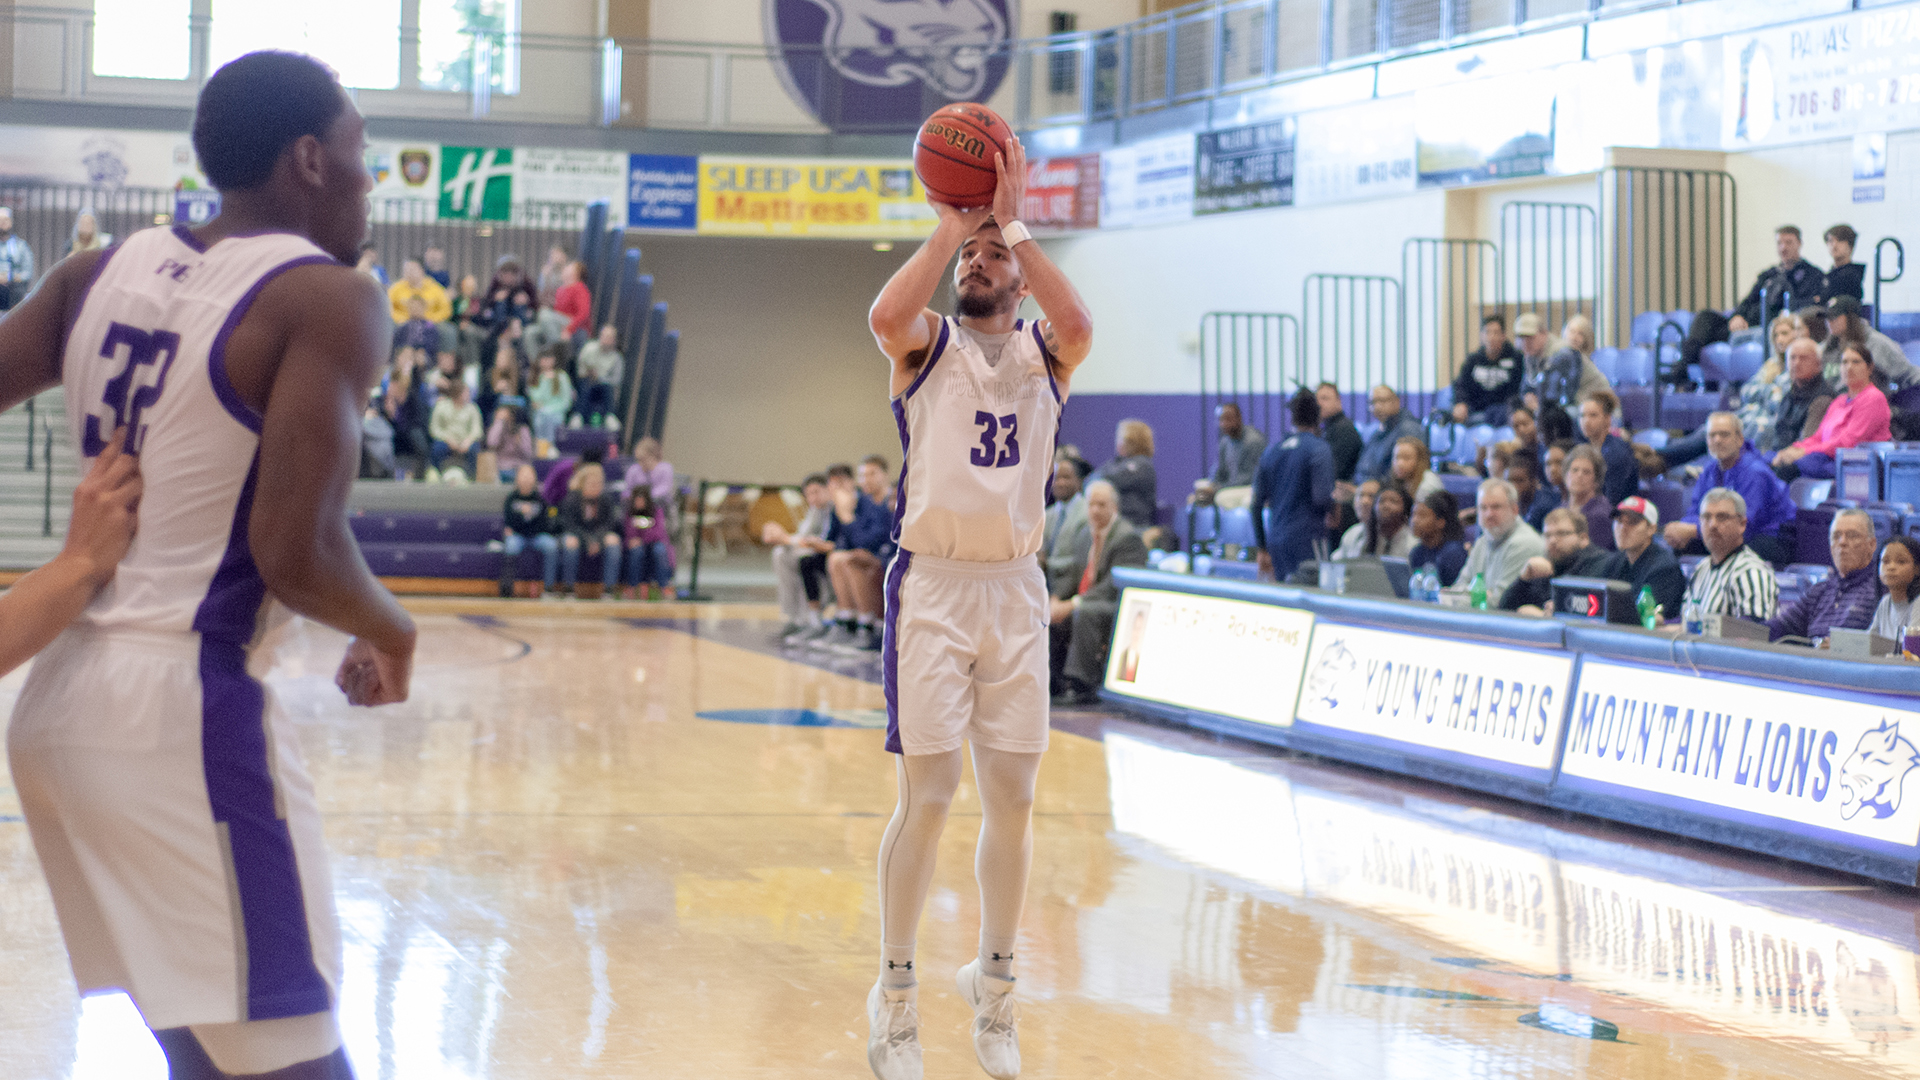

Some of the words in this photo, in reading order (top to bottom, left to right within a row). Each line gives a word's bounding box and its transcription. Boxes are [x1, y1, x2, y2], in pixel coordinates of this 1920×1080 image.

[925, 122, 987, 160] Wilson
[708, 165, 802, 193] SLEEP
[808, 166, 873, 194] USA
[714, 193, 870, 221] Mattress
[970, 410, 1020, 468] 33
[1362, 658, 1443, 724] YOUNG
[1447, 672, 1553, 746] HARRIS
[1572, 690, 1732, 780] MOUNTAIN
[1734, 717, 1838, 802] LIONS
